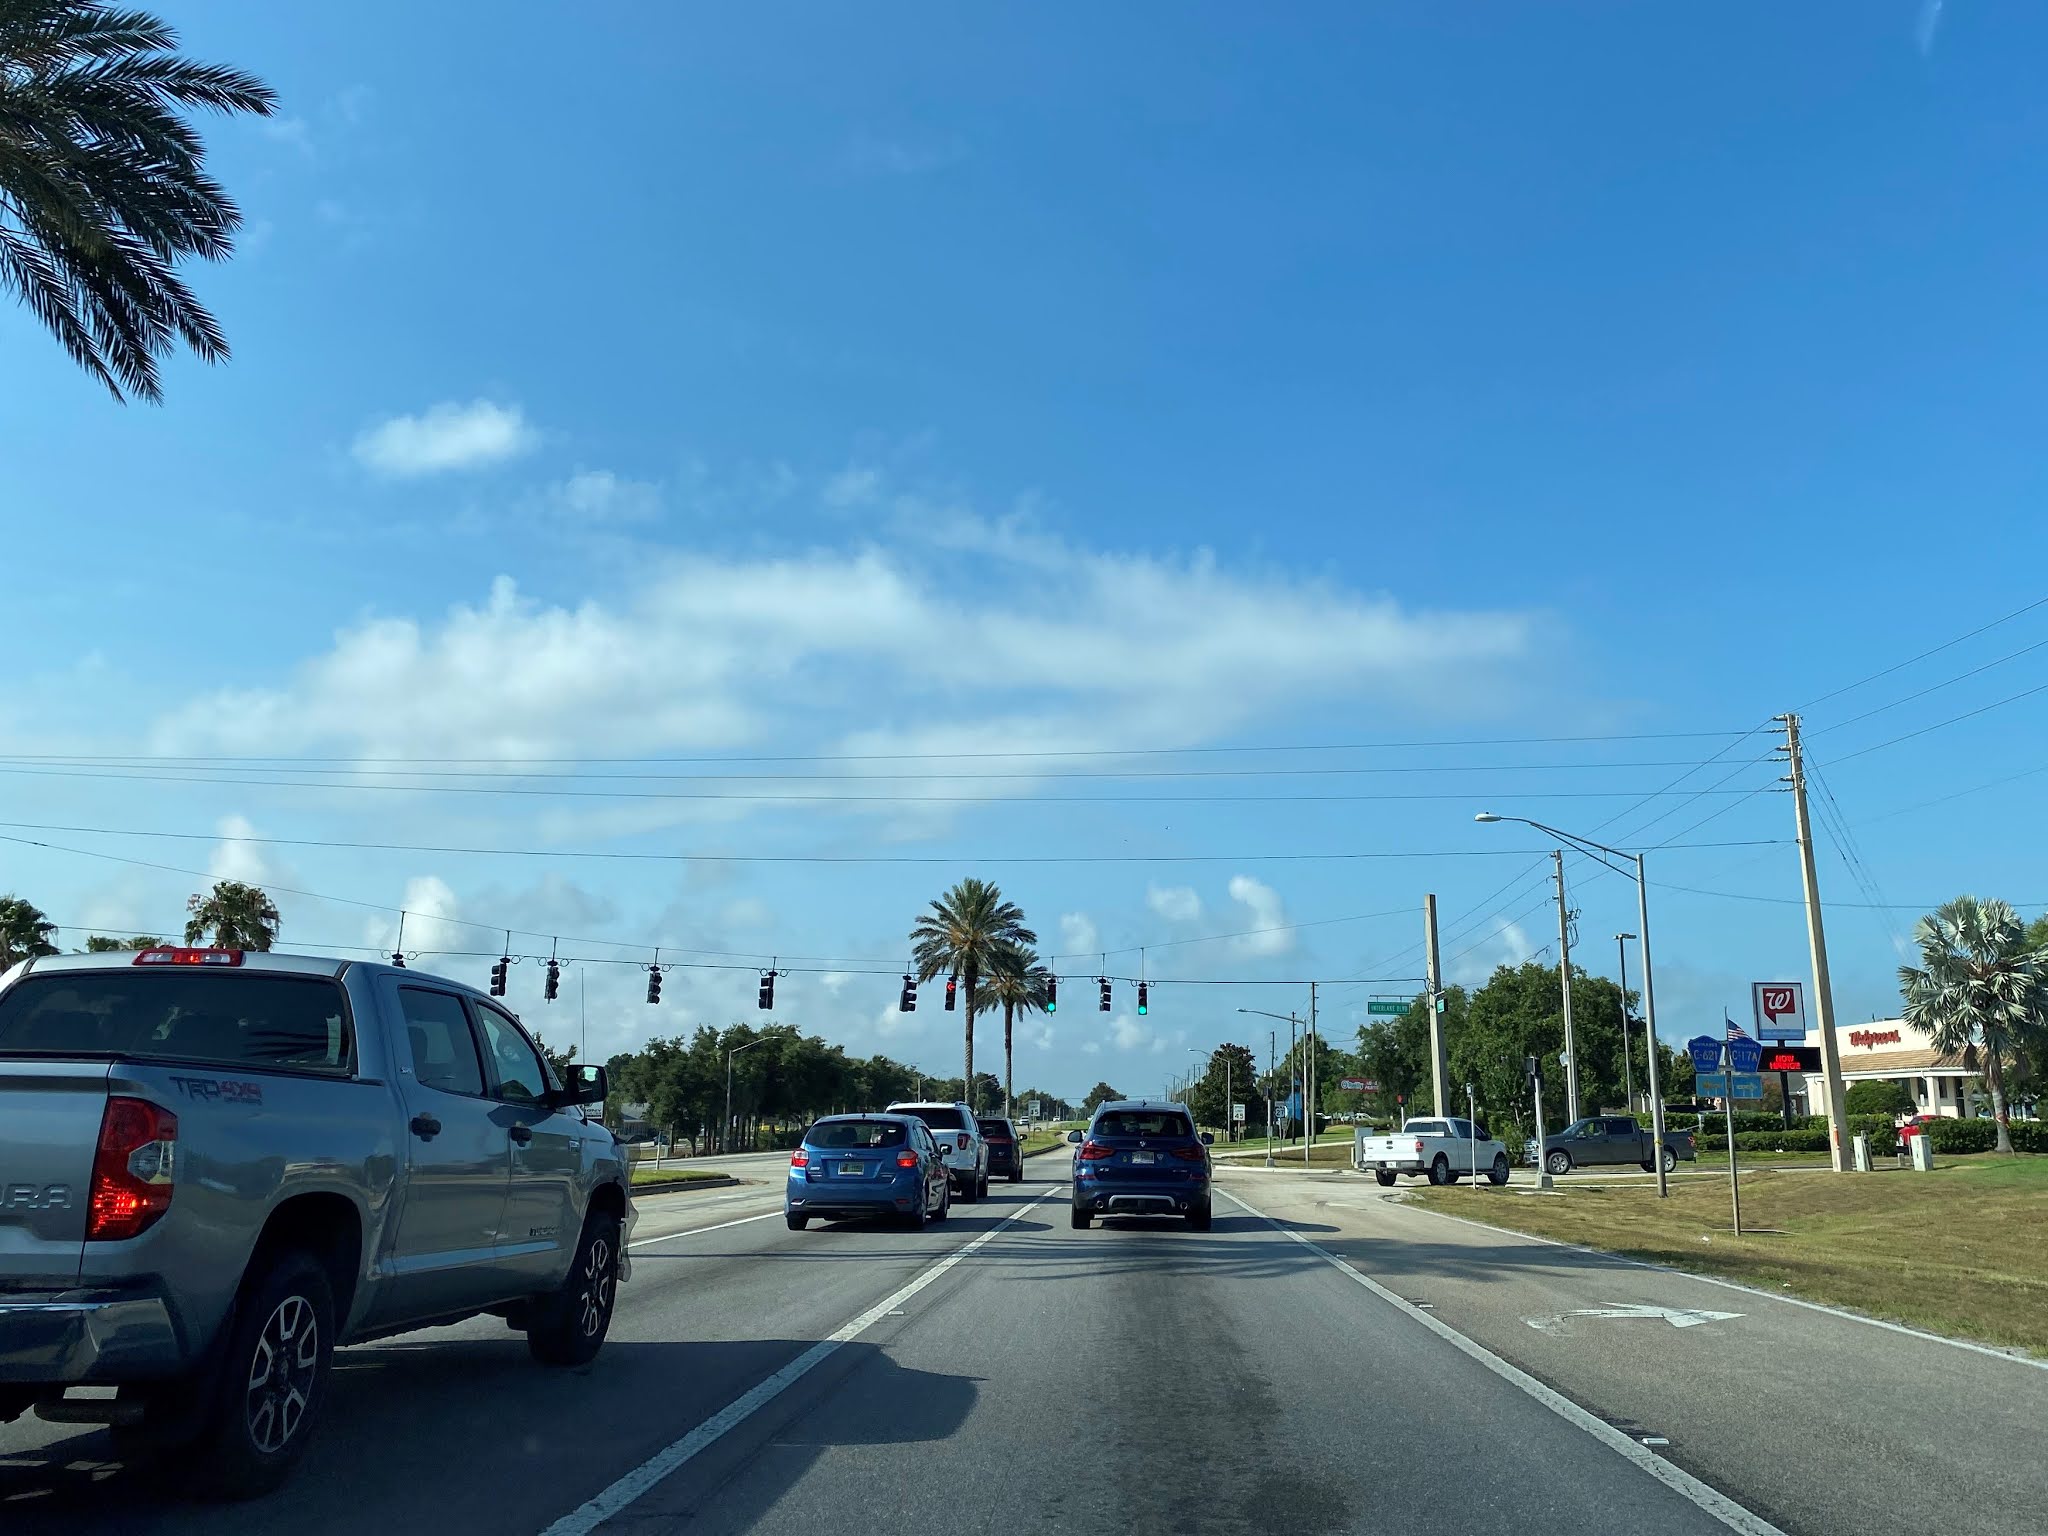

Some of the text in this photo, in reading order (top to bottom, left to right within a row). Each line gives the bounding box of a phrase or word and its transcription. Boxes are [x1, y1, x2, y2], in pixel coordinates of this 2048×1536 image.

[1765, 991, 1791, 1010] W
[1371, 1004, 1408, 1013] INTERLAKE BLVD
[1693, 1050, 1718, 1061] C-621
[1732, 1050, 1758, 1062] C-17A
[0, 1183, 72, 1209] RA
